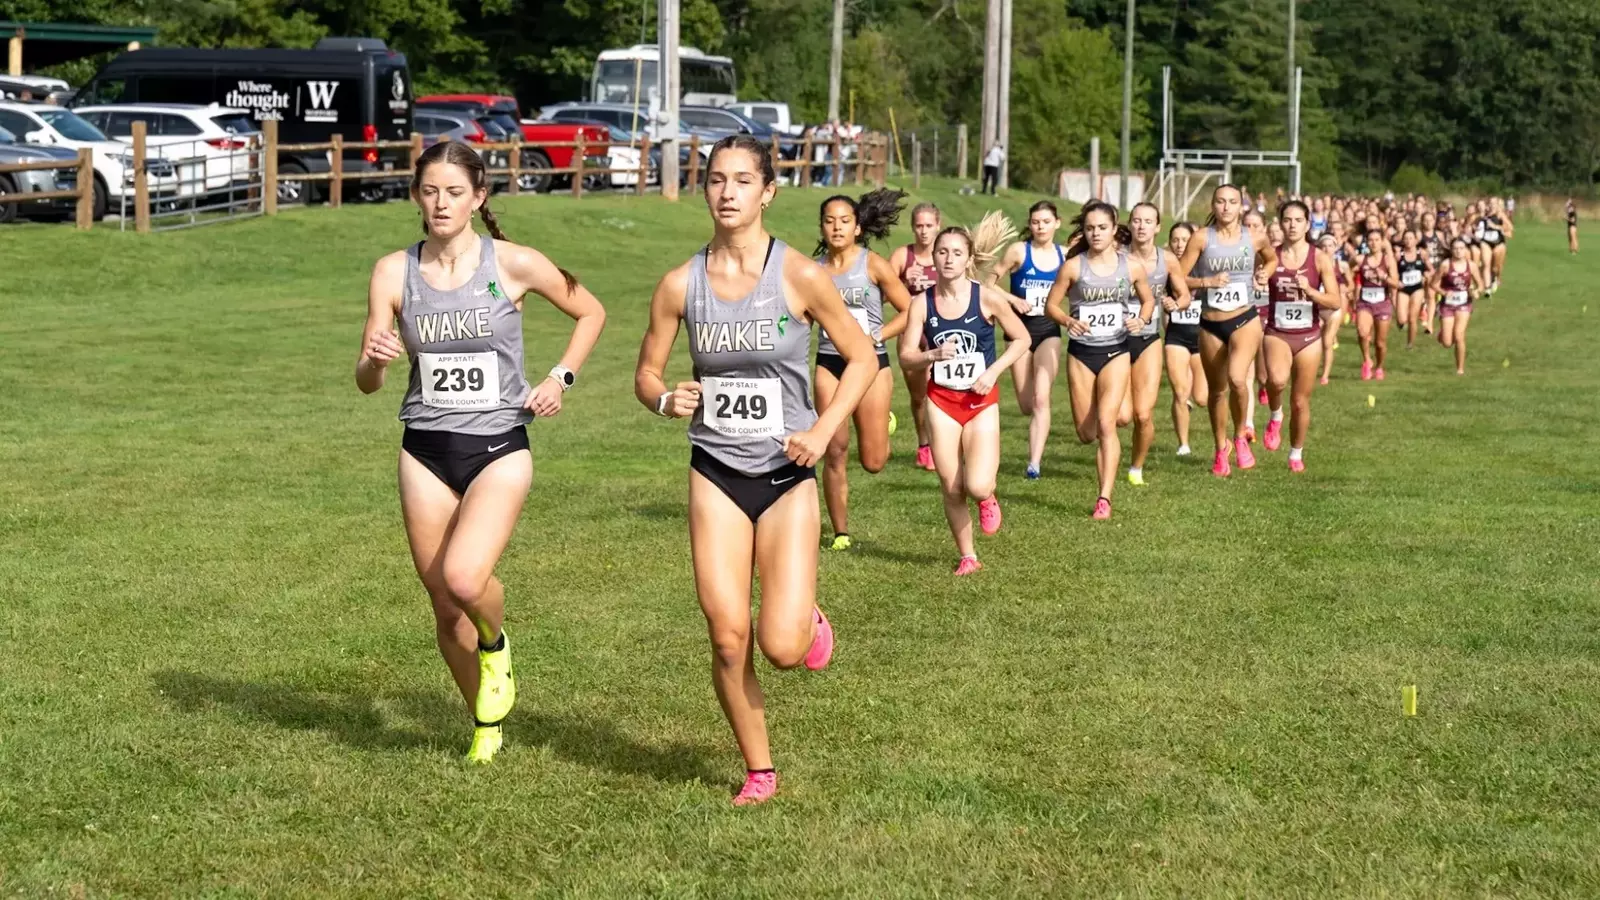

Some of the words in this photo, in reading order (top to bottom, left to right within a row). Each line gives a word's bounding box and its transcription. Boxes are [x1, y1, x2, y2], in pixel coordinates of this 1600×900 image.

[238, 81, 272, 92] Where
[225, 89, 290, 111] thought
[306, 81, 340, 109] W
[1209, 257, 1250, 270] WAKE
[1083, 287, 1123, 301] WAKE
[1214, 291, 1240, 303] 244
[1088, 313, 1115, 327] 242
[1179, 308, 1199, 319] 165
[1285, 309, 1302, 320] 52
[415, 306, 493, 344] WAKE
[694, 319, 775, 353] WAKE
[943, 362, 976, 379] 147
[432, 367, 485, 392] 239
[431, 398, 455, 406] CROSS
[456, 398, 490, 406] COUNTRY
[715, 394, 768, 420] 249
[714, 426, 737, 434] CROSS
[738, 426, 773, 434] COUNTRY
